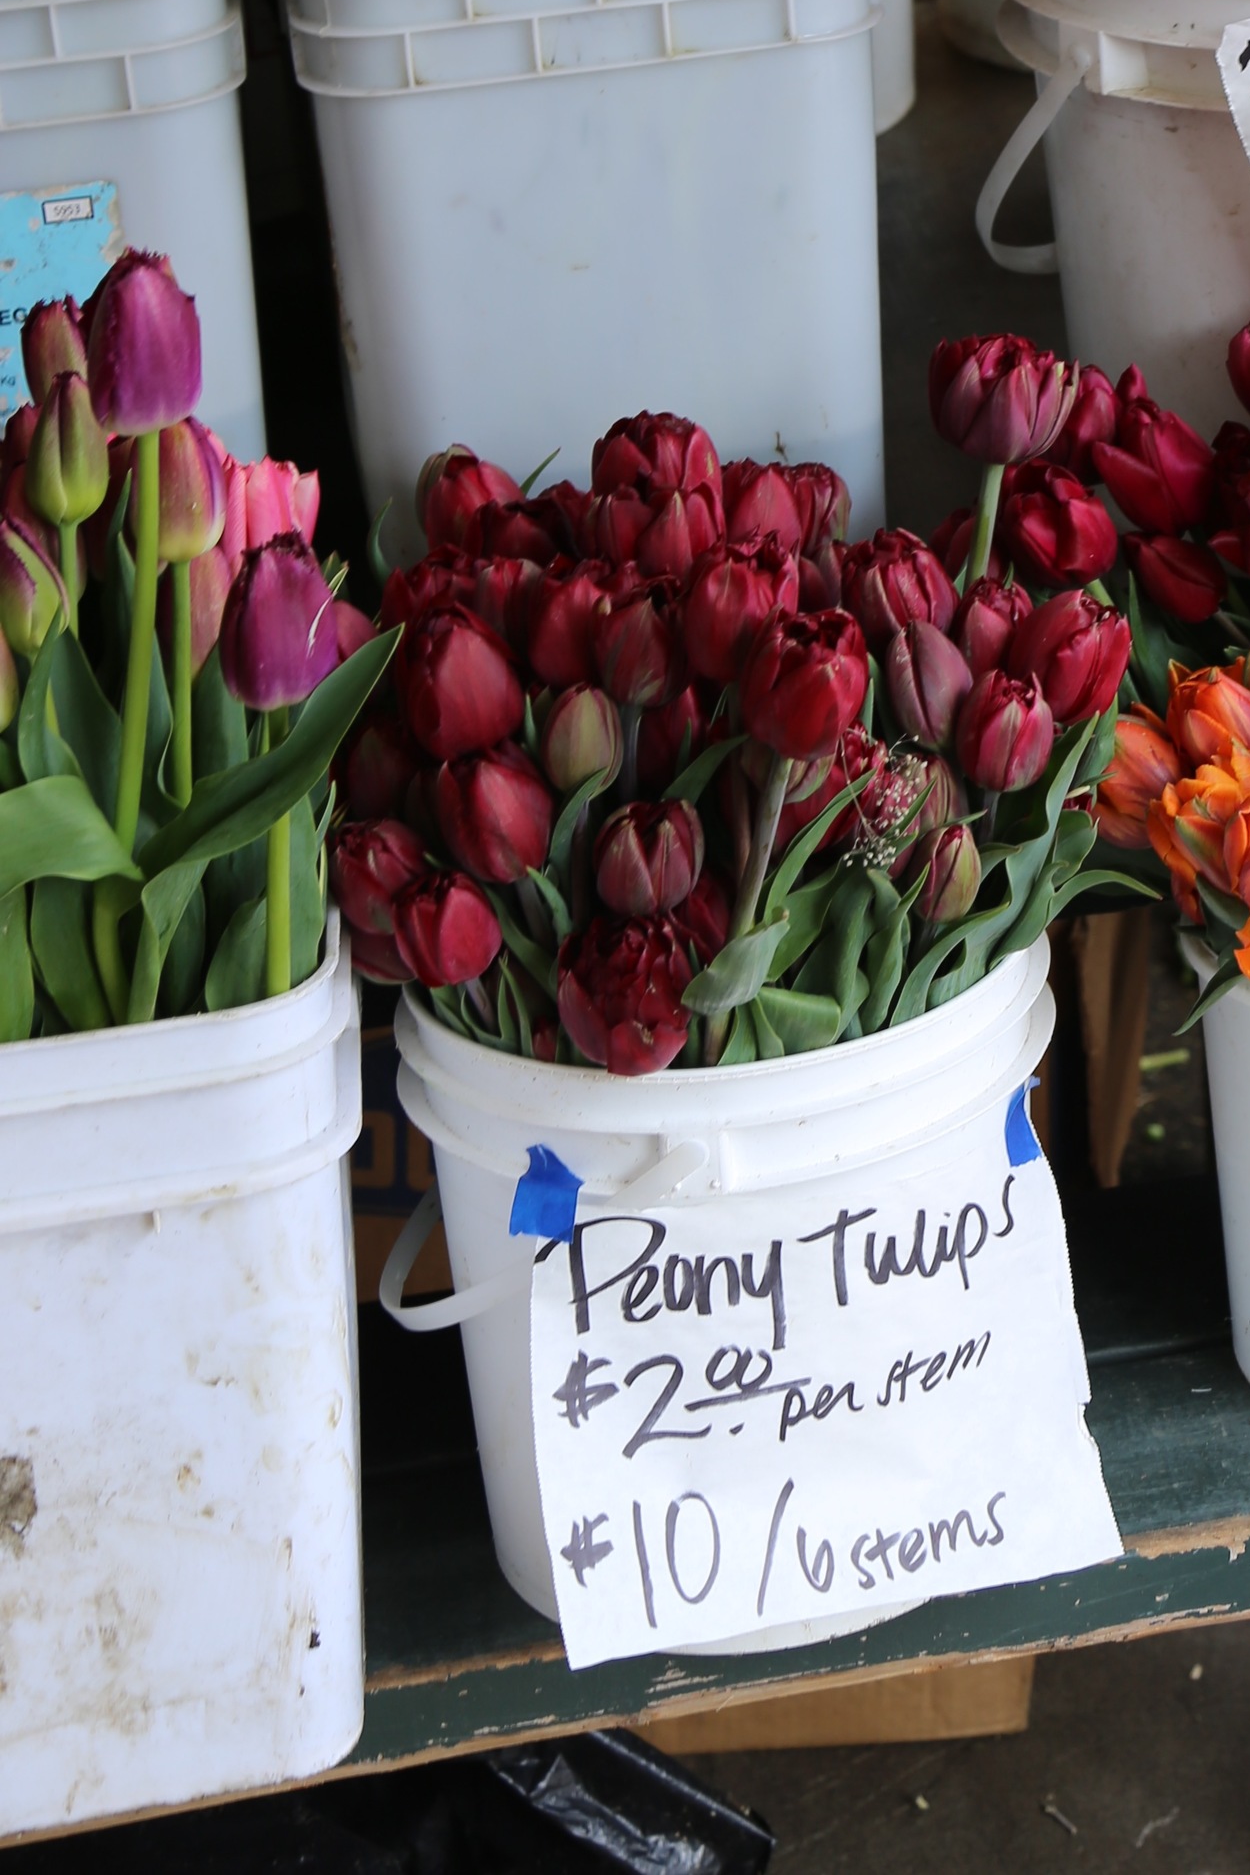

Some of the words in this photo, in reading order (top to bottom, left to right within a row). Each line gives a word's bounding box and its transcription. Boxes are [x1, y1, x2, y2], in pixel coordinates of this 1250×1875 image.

[535, 1215, 787, 1350] Peony
[796, 1174, 1016, 1307] Tulips
[779, 1382, 864, 1442] per
[876, 1331, 992, 1407] stem
